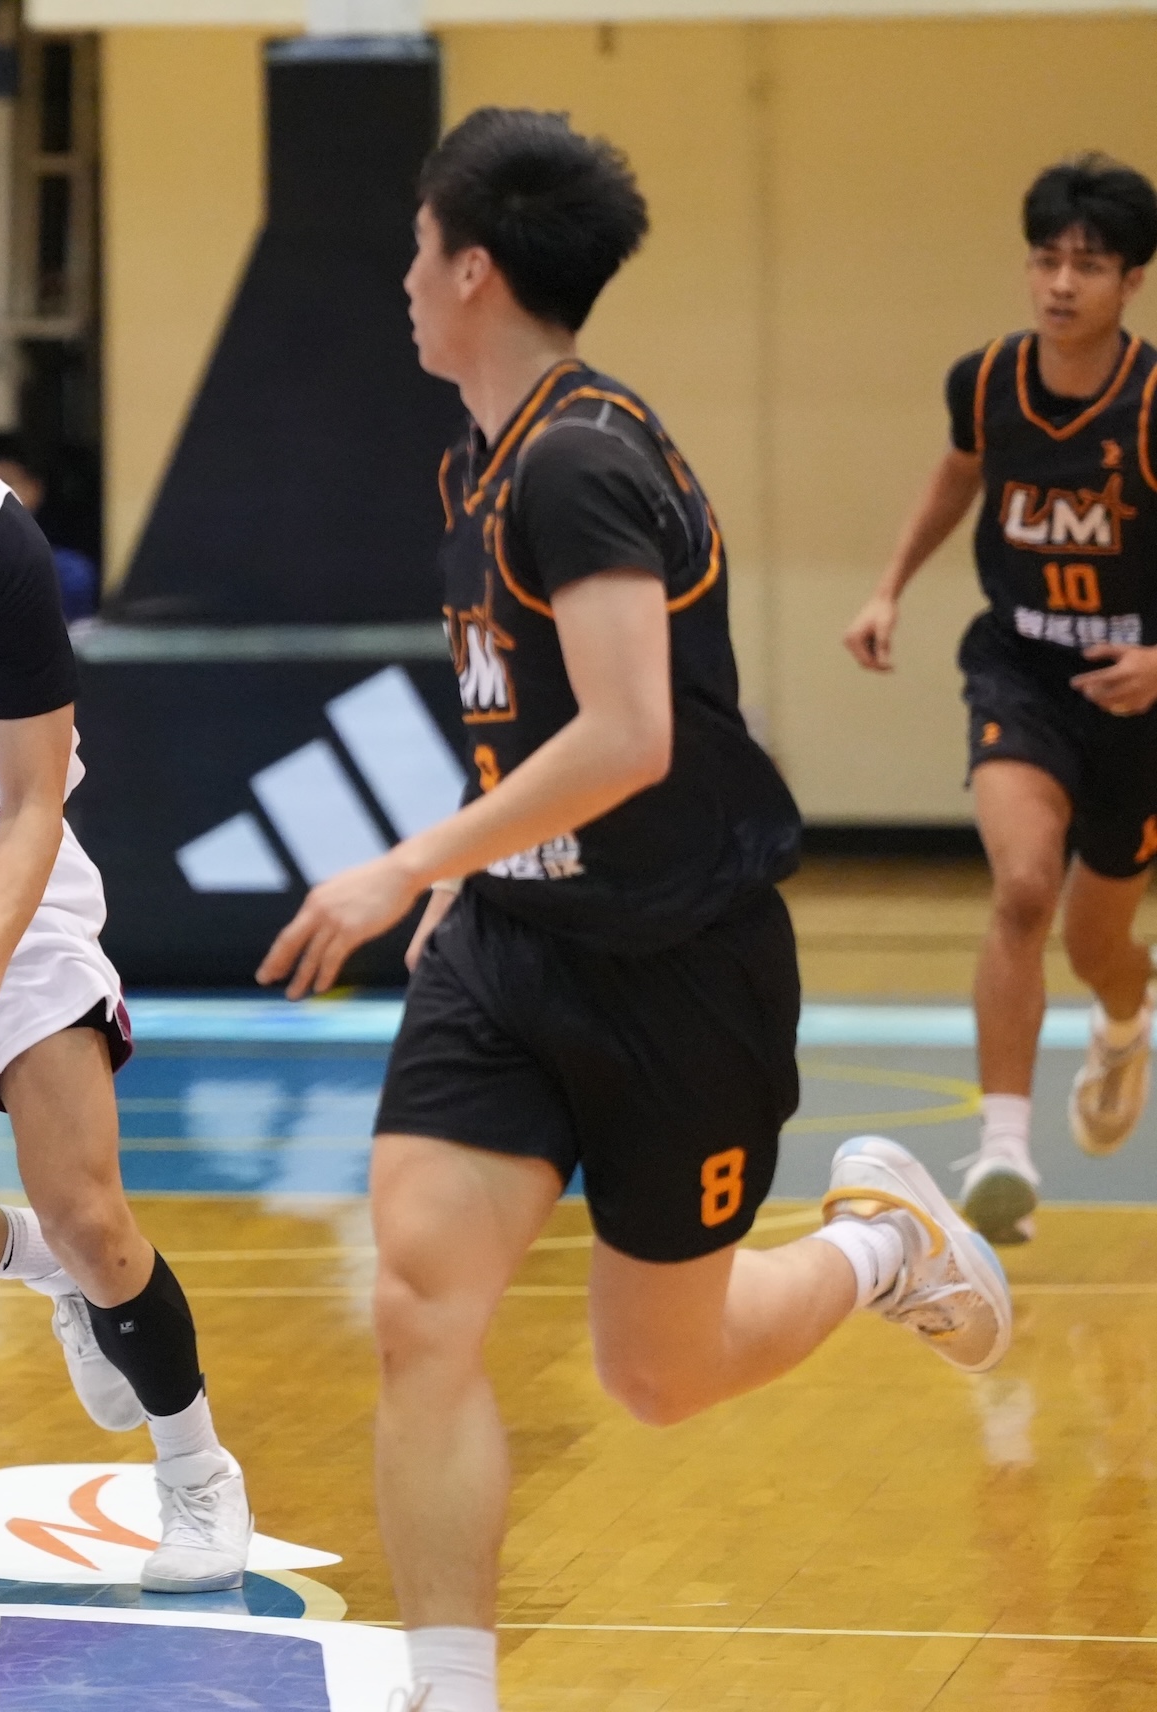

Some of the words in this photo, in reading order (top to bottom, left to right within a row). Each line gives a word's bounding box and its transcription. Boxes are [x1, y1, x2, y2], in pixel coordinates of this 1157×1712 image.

[1001, 482, 1121, 552] LM
[1043, 562, 1101, 612] 10
[701, 1148, 746, 1228] 8
